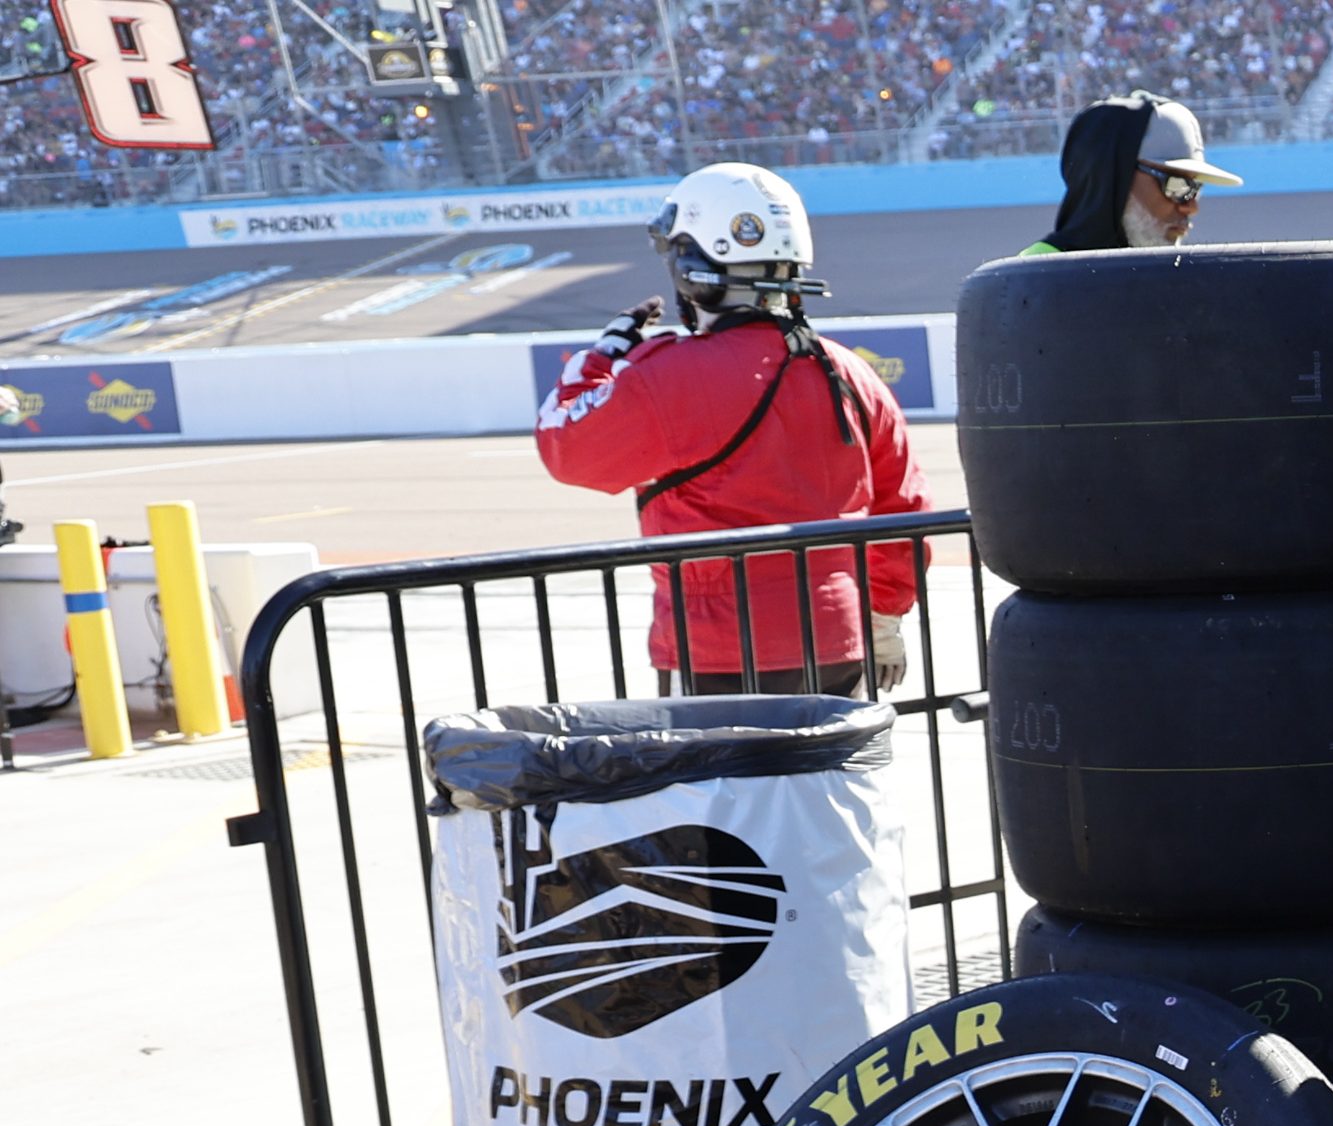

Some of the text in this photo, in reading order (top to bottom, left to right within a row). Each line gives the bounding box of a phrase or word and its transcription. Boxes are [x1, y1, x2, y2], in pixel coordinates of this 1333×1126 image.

[50, 0, 214, 150] 8
[247, 213, 336, 235] PHOENIX
[339, 208, 431, 229] RACEWAY
[481, 200, 571, 222] PHOENIX
[1289, 349, 1323, 403] F
